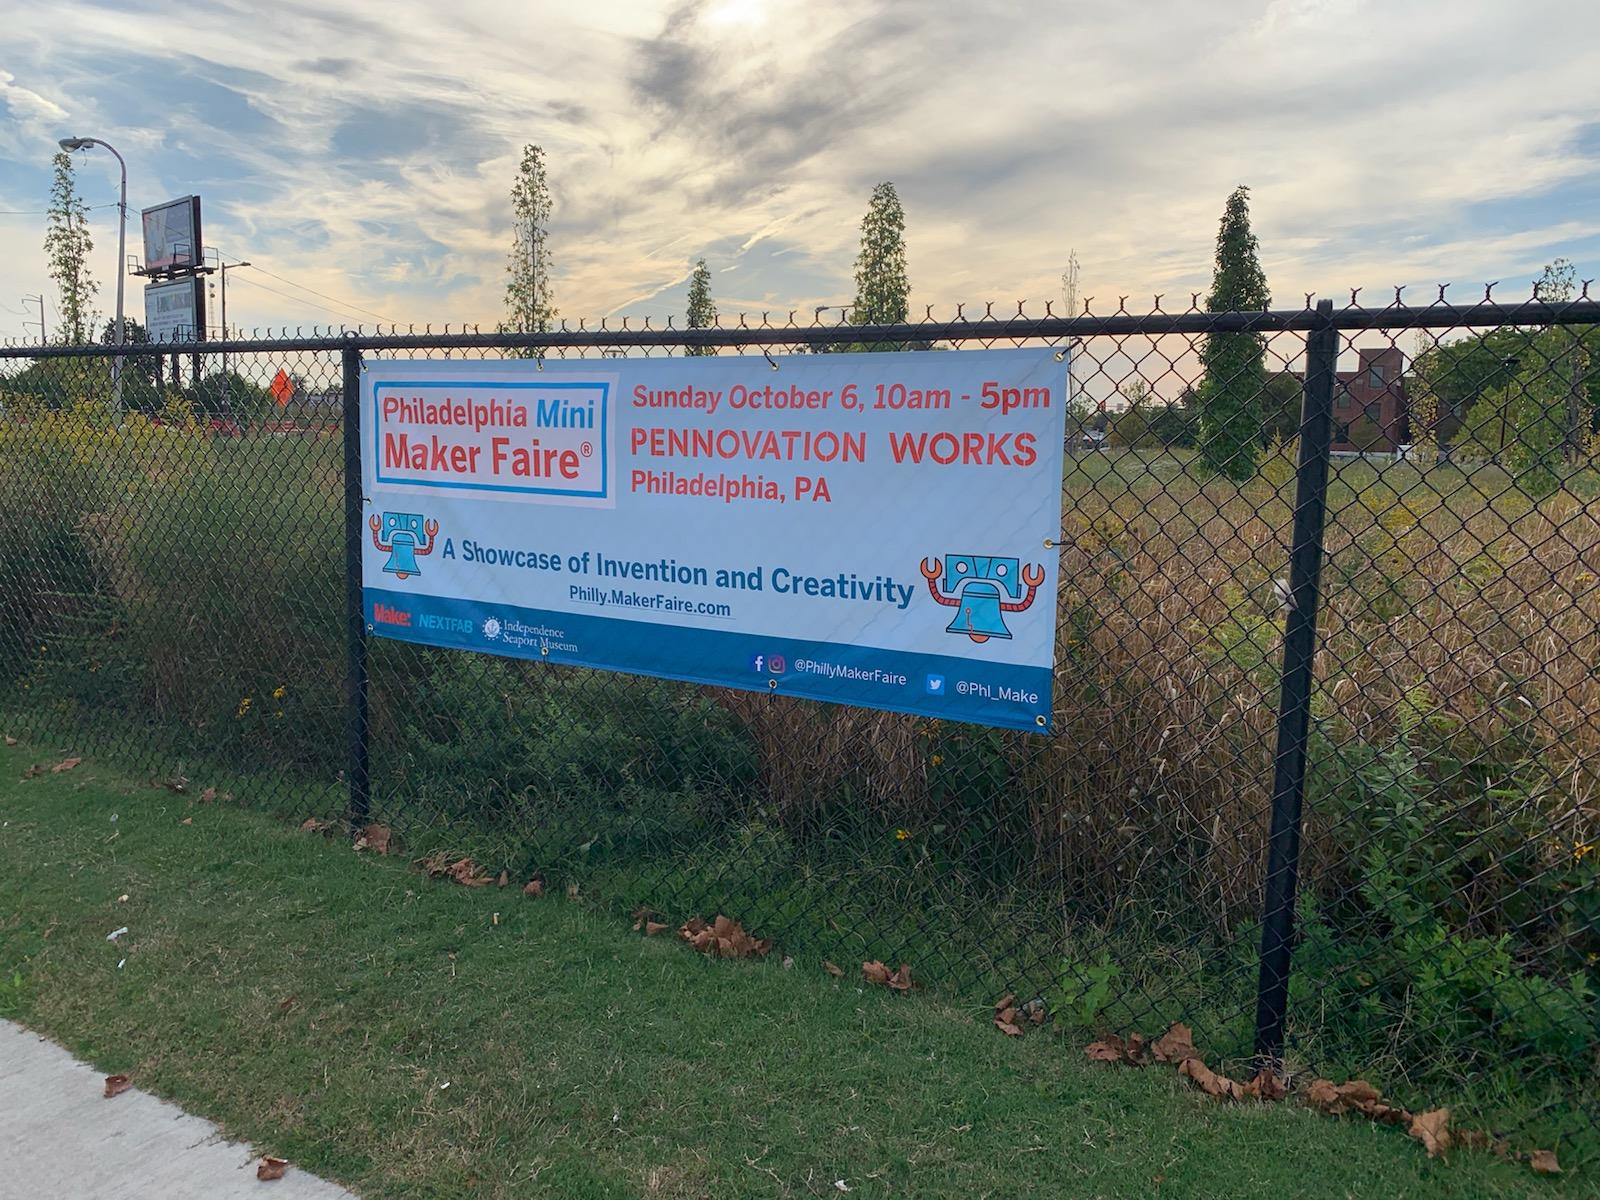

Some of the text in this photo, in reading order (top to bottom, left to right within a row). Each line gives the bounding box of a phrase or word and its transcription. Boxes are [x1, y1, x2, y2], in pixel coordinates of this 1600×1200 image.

[383, 397, 594, 432] Philadelphia Mini
[632, 384, 722, 414] Sunday
[729, 384, 833, 410] October
[841, 384, 865, 413] 6,
[873, 383, 951, 409] 10am
[980, 382, 1050, 415] 5pm
[385, 433, 481, 473] Maker
[631, 428, 1037, 467] PENNOVATION WORKS
[631, 470, 832, 503] Philadelphia, PA
[442, 538, 915, 610] A Showcase of Invention and Creativity
[374, 603, 412, 627] Make:
[569, 585, 731, 617] Philly.MakerFaire.com
[419, 614, 473, 634] NEXTFAB
[503, 620, 564, 639] Independence
[503, 632, 578, 653] Seaport Museum
[795, 659, 907, 686] @PhillyMakerFaire
[956, 681, 1039, 704] @Phl_Make
